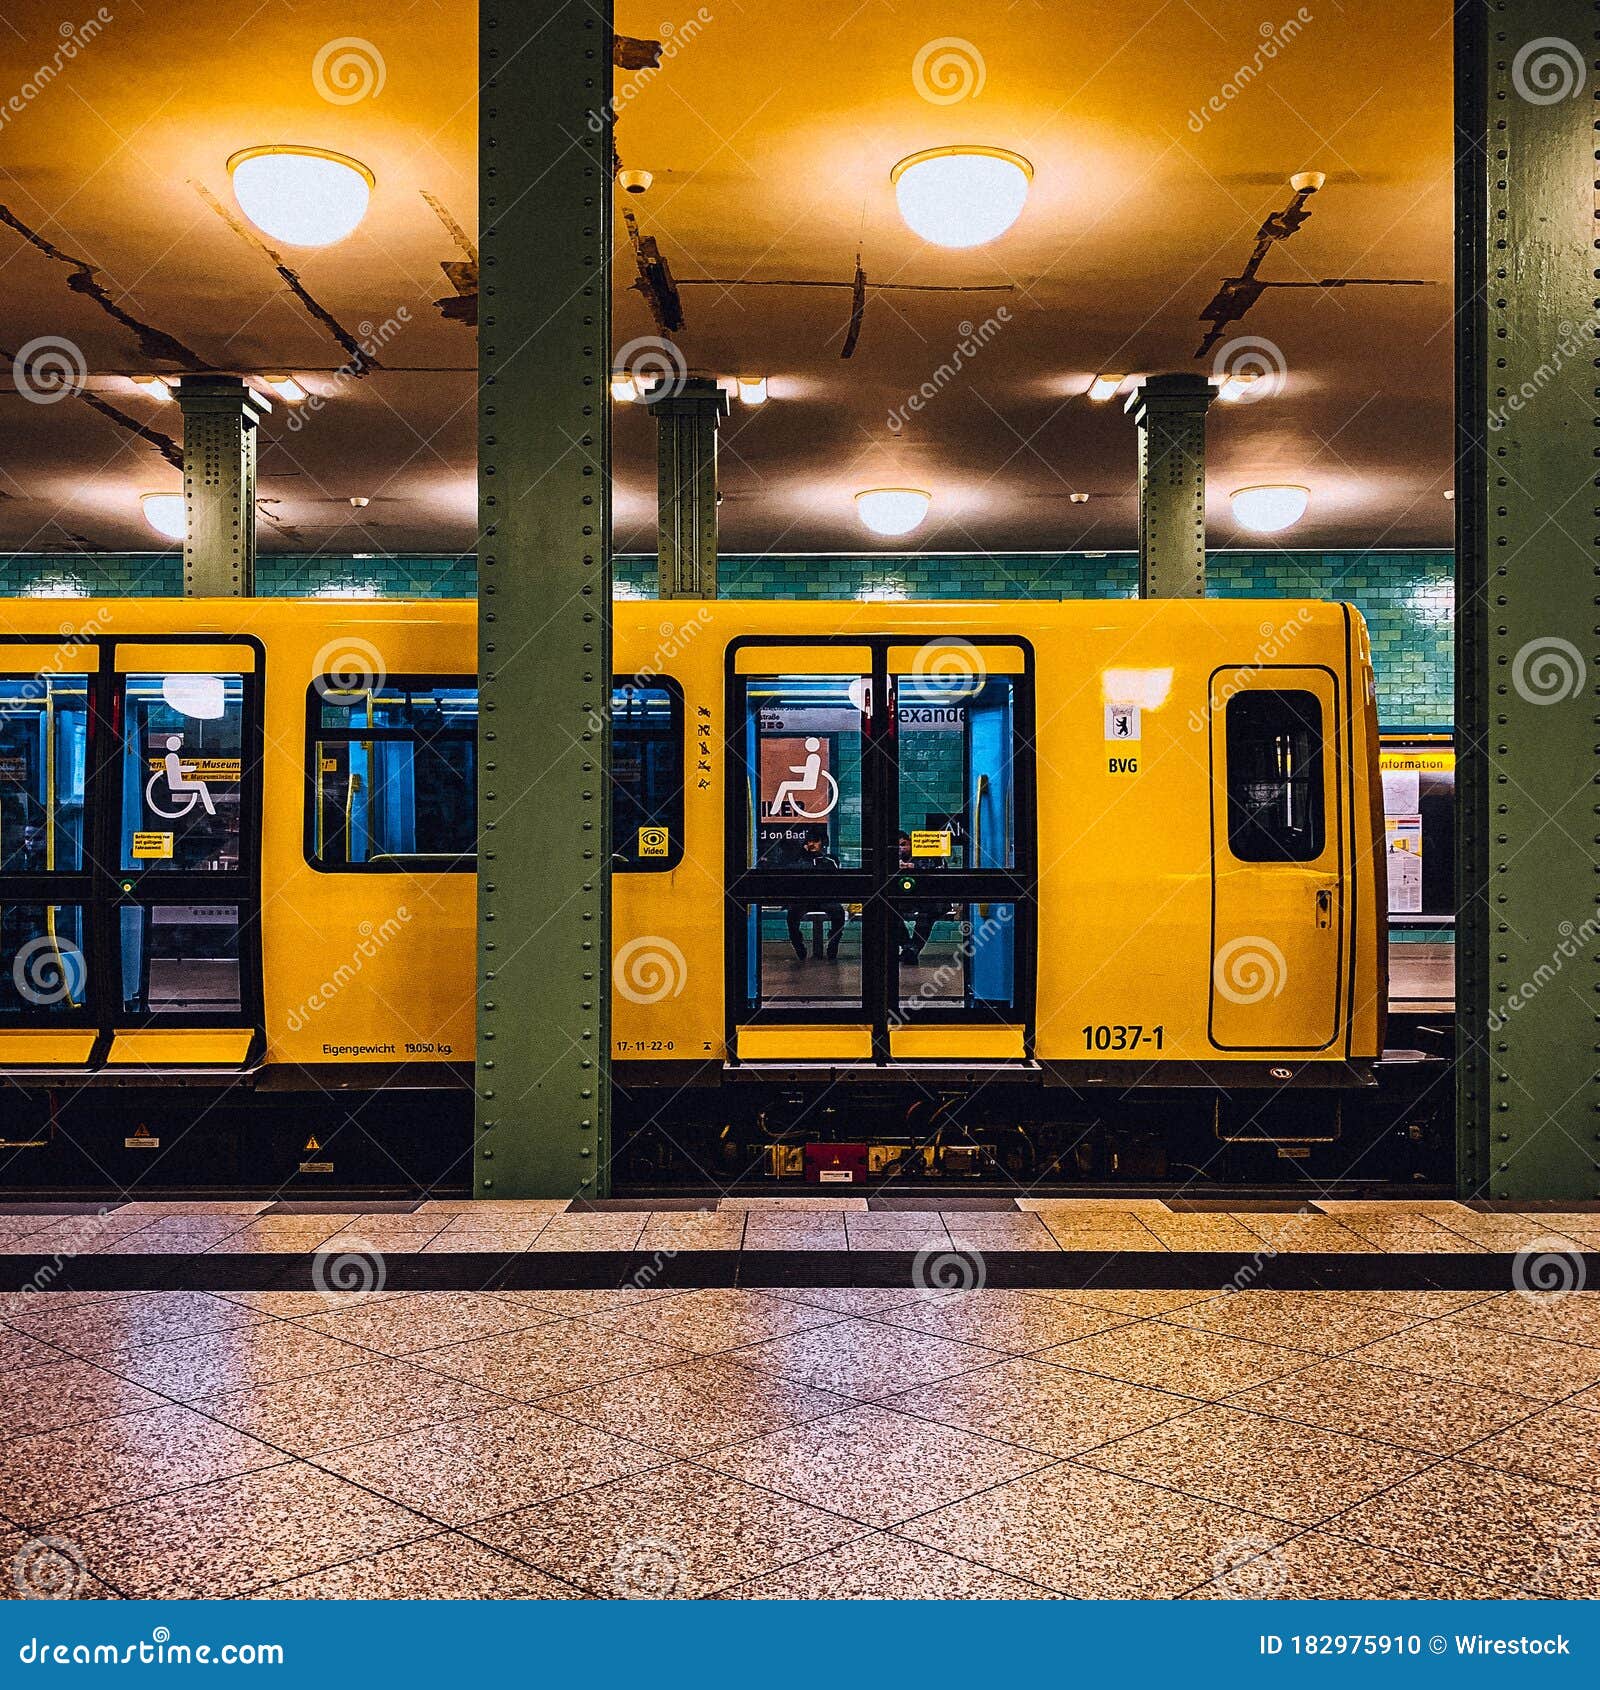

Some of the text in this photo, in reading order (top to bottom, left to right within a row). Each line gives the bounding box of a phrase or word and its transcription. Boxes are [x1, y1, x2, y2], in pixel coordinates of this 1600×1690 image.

[1109, 758, 1137, 773] BVG
[643, 847, 664, 855] Video
[1082, 1025, 1163, 1050] 1037-1
[323, 1043, 395, 1056] Eigengewicht
